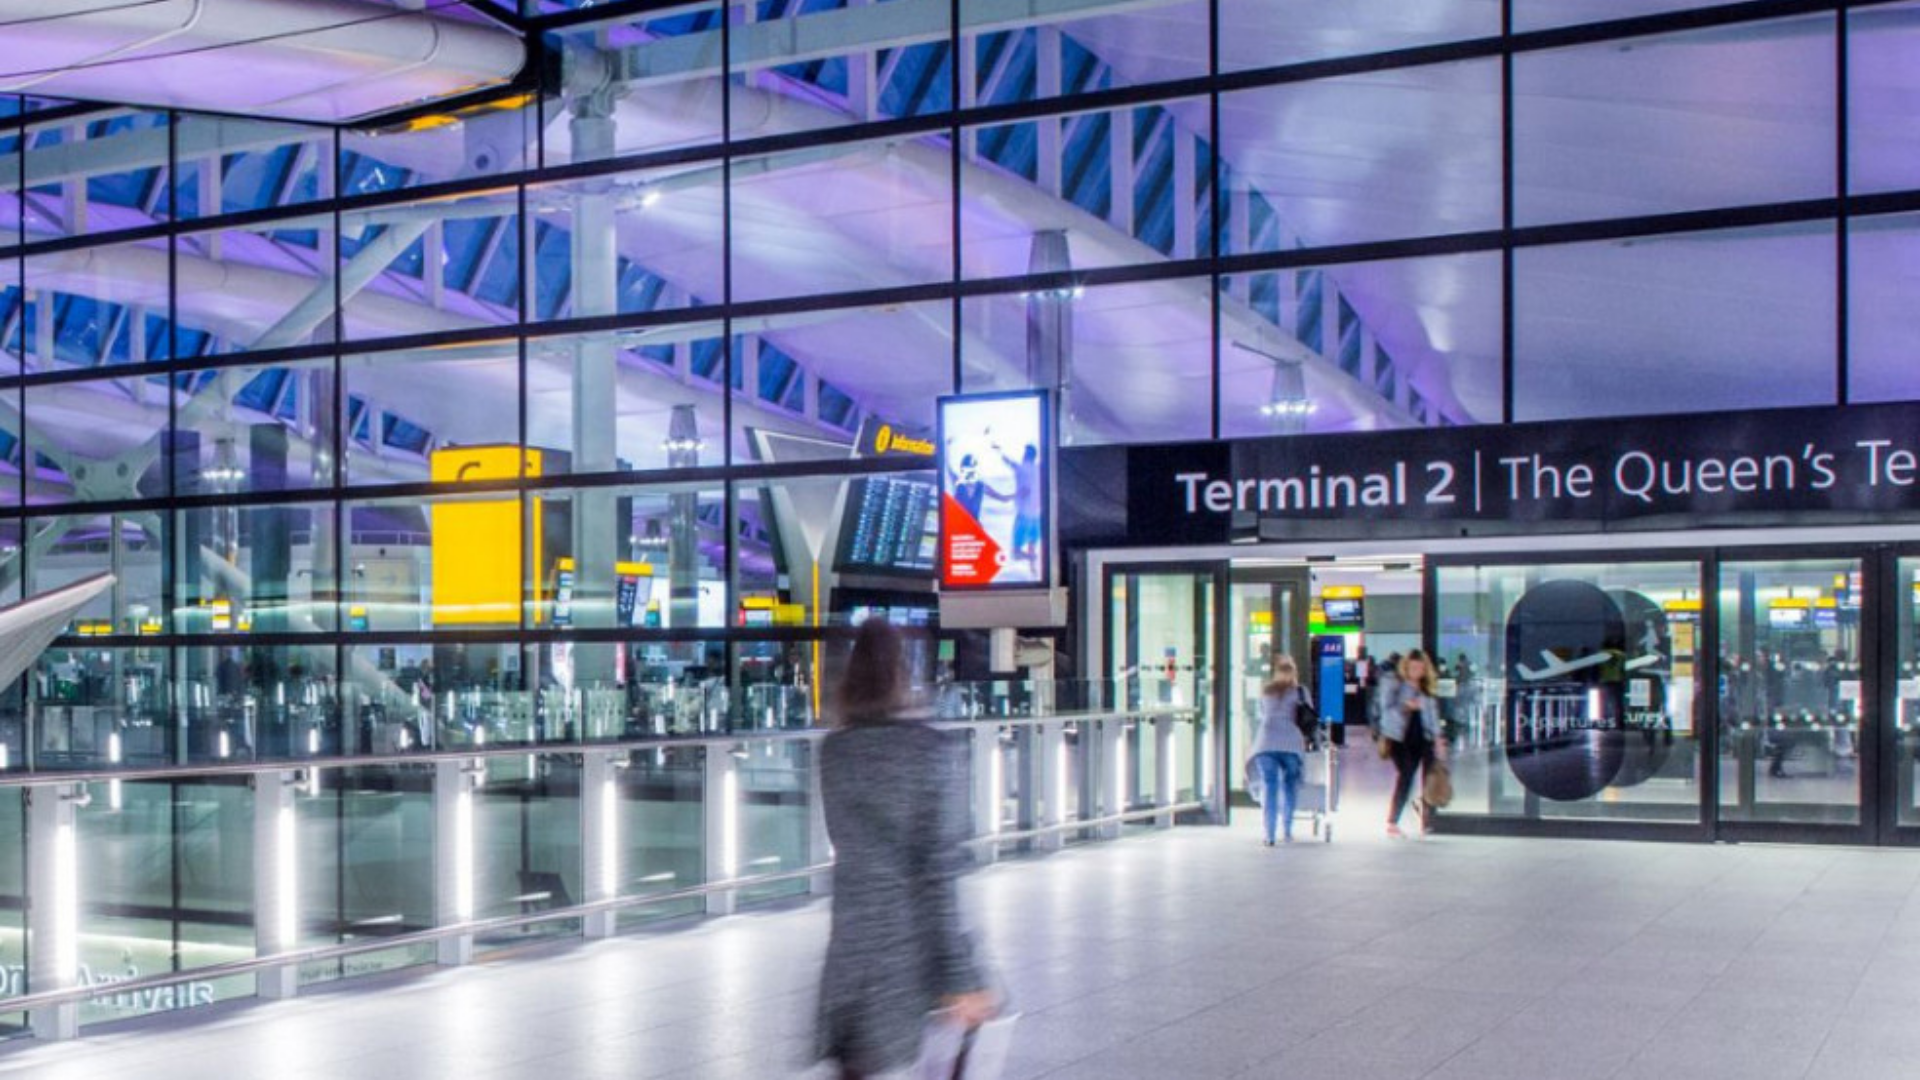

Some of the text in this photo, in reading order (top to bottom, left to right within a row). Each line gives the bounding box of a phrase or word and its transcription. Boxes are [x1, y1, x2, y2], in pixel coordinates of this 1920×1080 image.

[1175, 461, 1455, 513] Terminal 2
[1499, 440, 1917, 502] The Queen's Te
